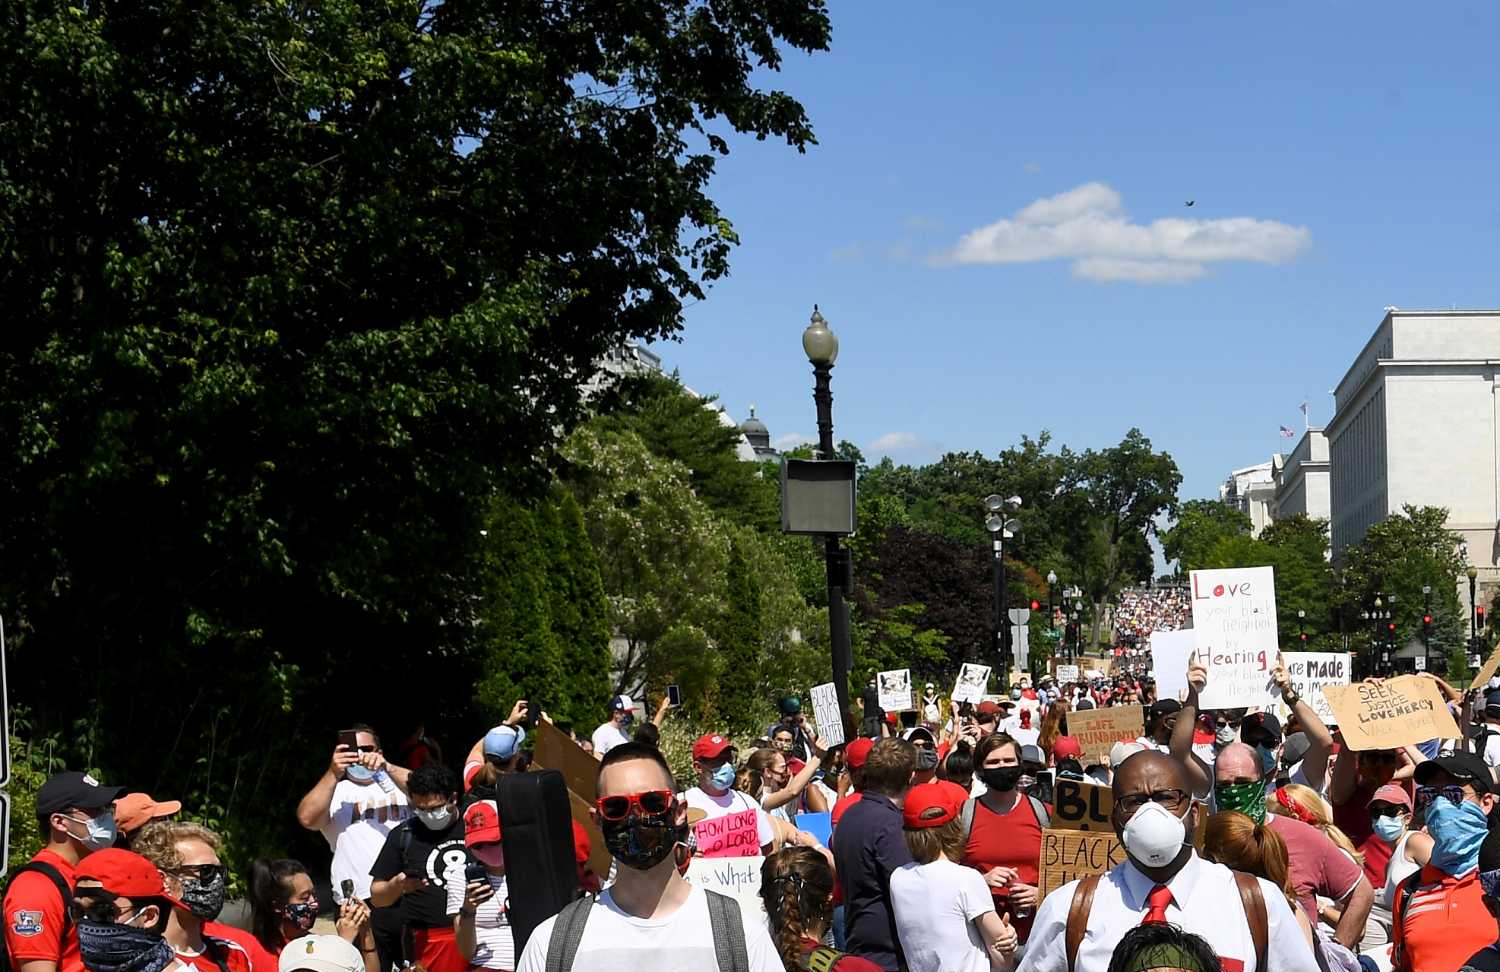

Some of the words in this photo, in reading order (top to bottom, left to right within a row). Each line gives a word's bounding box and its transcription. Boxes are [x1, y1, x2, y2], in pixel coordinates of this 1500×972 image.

[1193, 573, 1252, 600] Love
[1197, 646, 1267, 671] Hearing
[1307, 659, 1344, 678] made
[1359, 684, 1398, 699] SEEK
[1361, 695, 1409, 712] JUSTICE
[697, 821, 724, 839] HOW
[728, 813, 755, 831] LONG
[727, 829, 756, 848] LORD
[1045, 835, 1121, 869] BLACK
